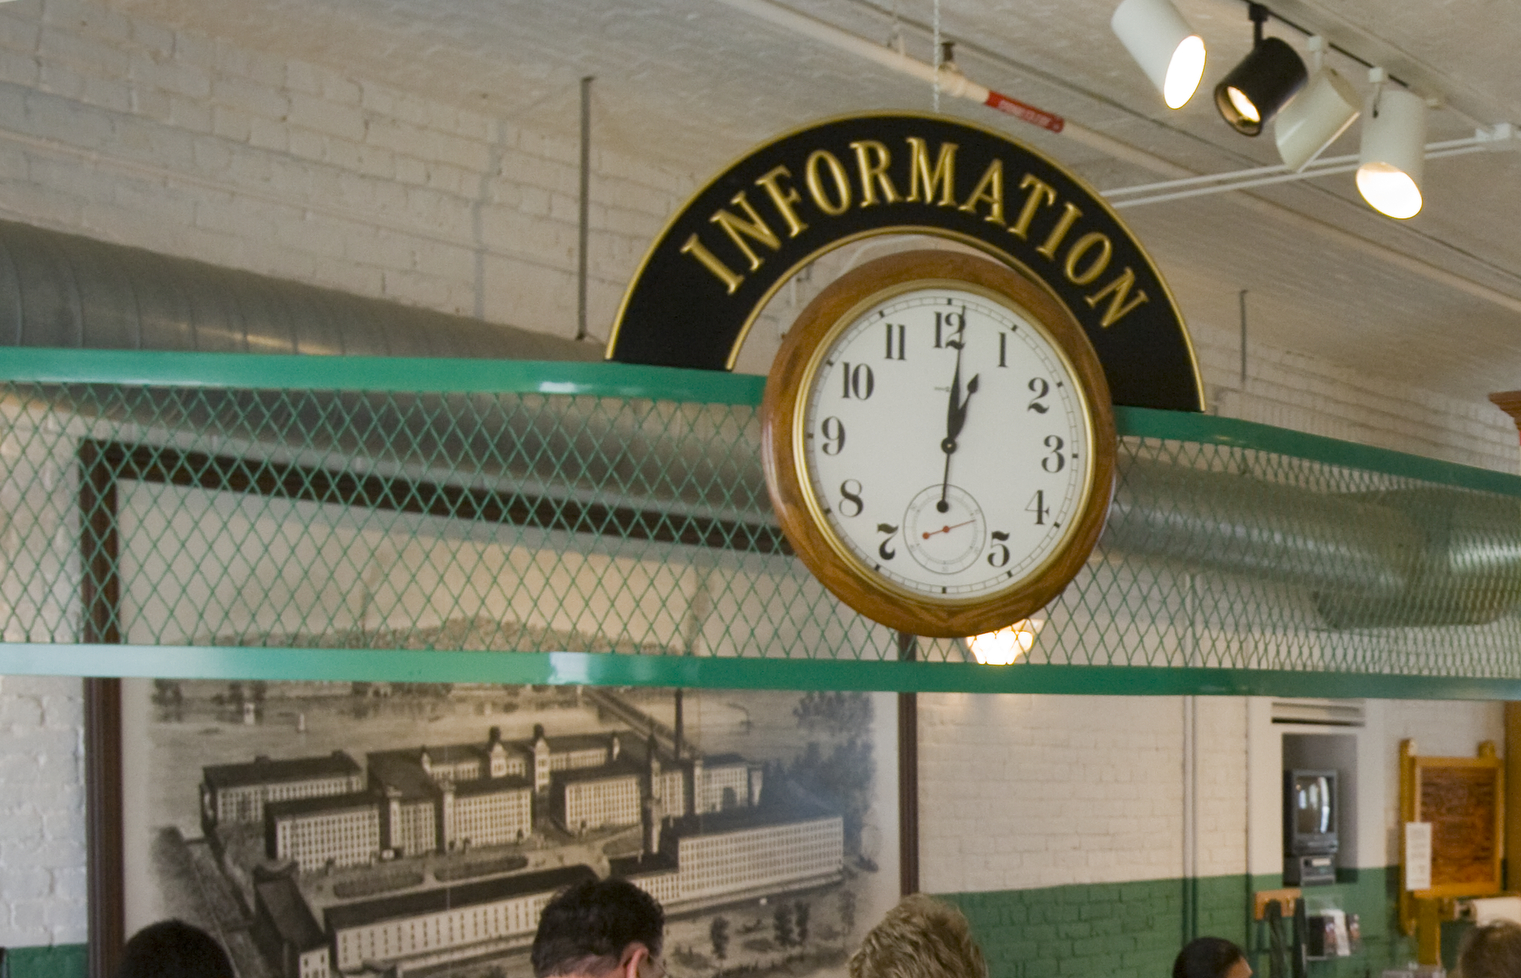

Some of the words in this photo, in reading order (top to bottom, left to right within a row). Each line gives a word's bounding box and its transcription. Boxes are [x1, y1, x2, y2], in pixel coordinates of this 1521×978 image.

[680, 137, 1149, 328] INFORMATION
[884, 323, 907, 361] 11
[933, 311, 966, 349] 12
[998, 332, 1008, 368] 1
[841, 362, 875, 400] 10
[1027, 377, 1049, 414] 2
[821, 416, 845, 456] 9
[1041, 435, 1065, 473] 3
[838, 478, 864, 517] 8
[1024, 489, 1049, 525] 4
[876, 523, 898, 561] 7
[987, 530, 1010, 567] 5
